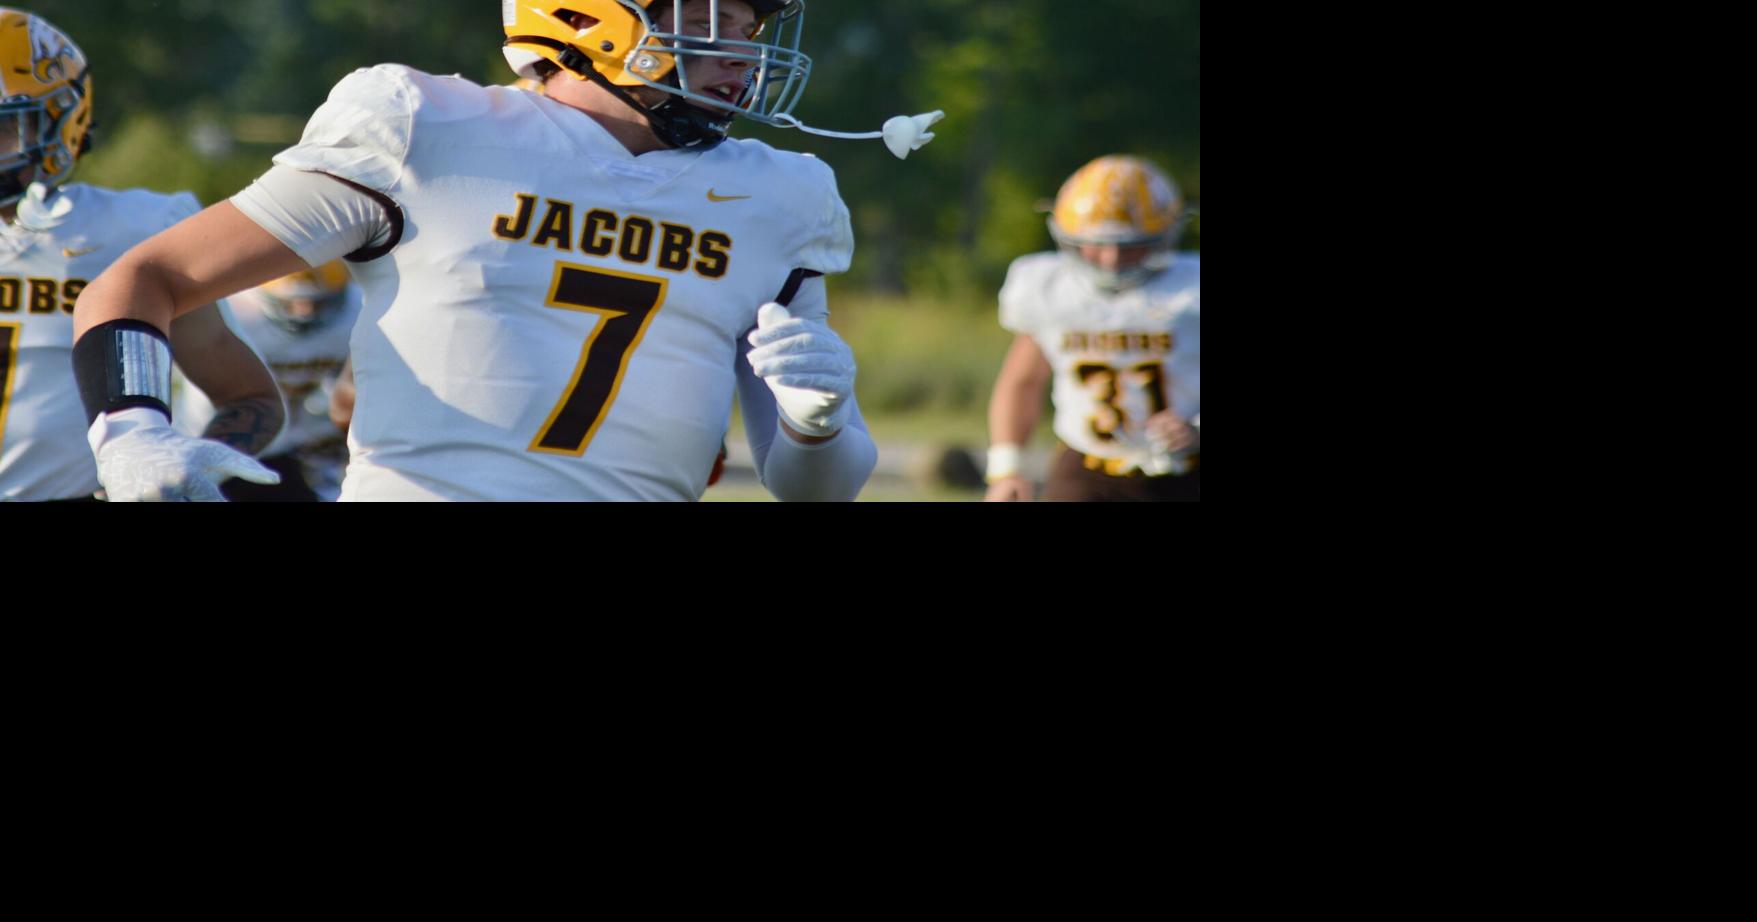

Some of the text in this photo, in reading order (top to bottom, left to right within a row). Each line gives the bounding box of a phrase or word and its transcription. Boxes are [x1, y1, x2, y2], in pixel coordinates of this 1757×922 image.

[492, 192, 732, 279] JACOBS
[526, 260, 669, 457] 7
[1073, 360, 1168, 441] 31
